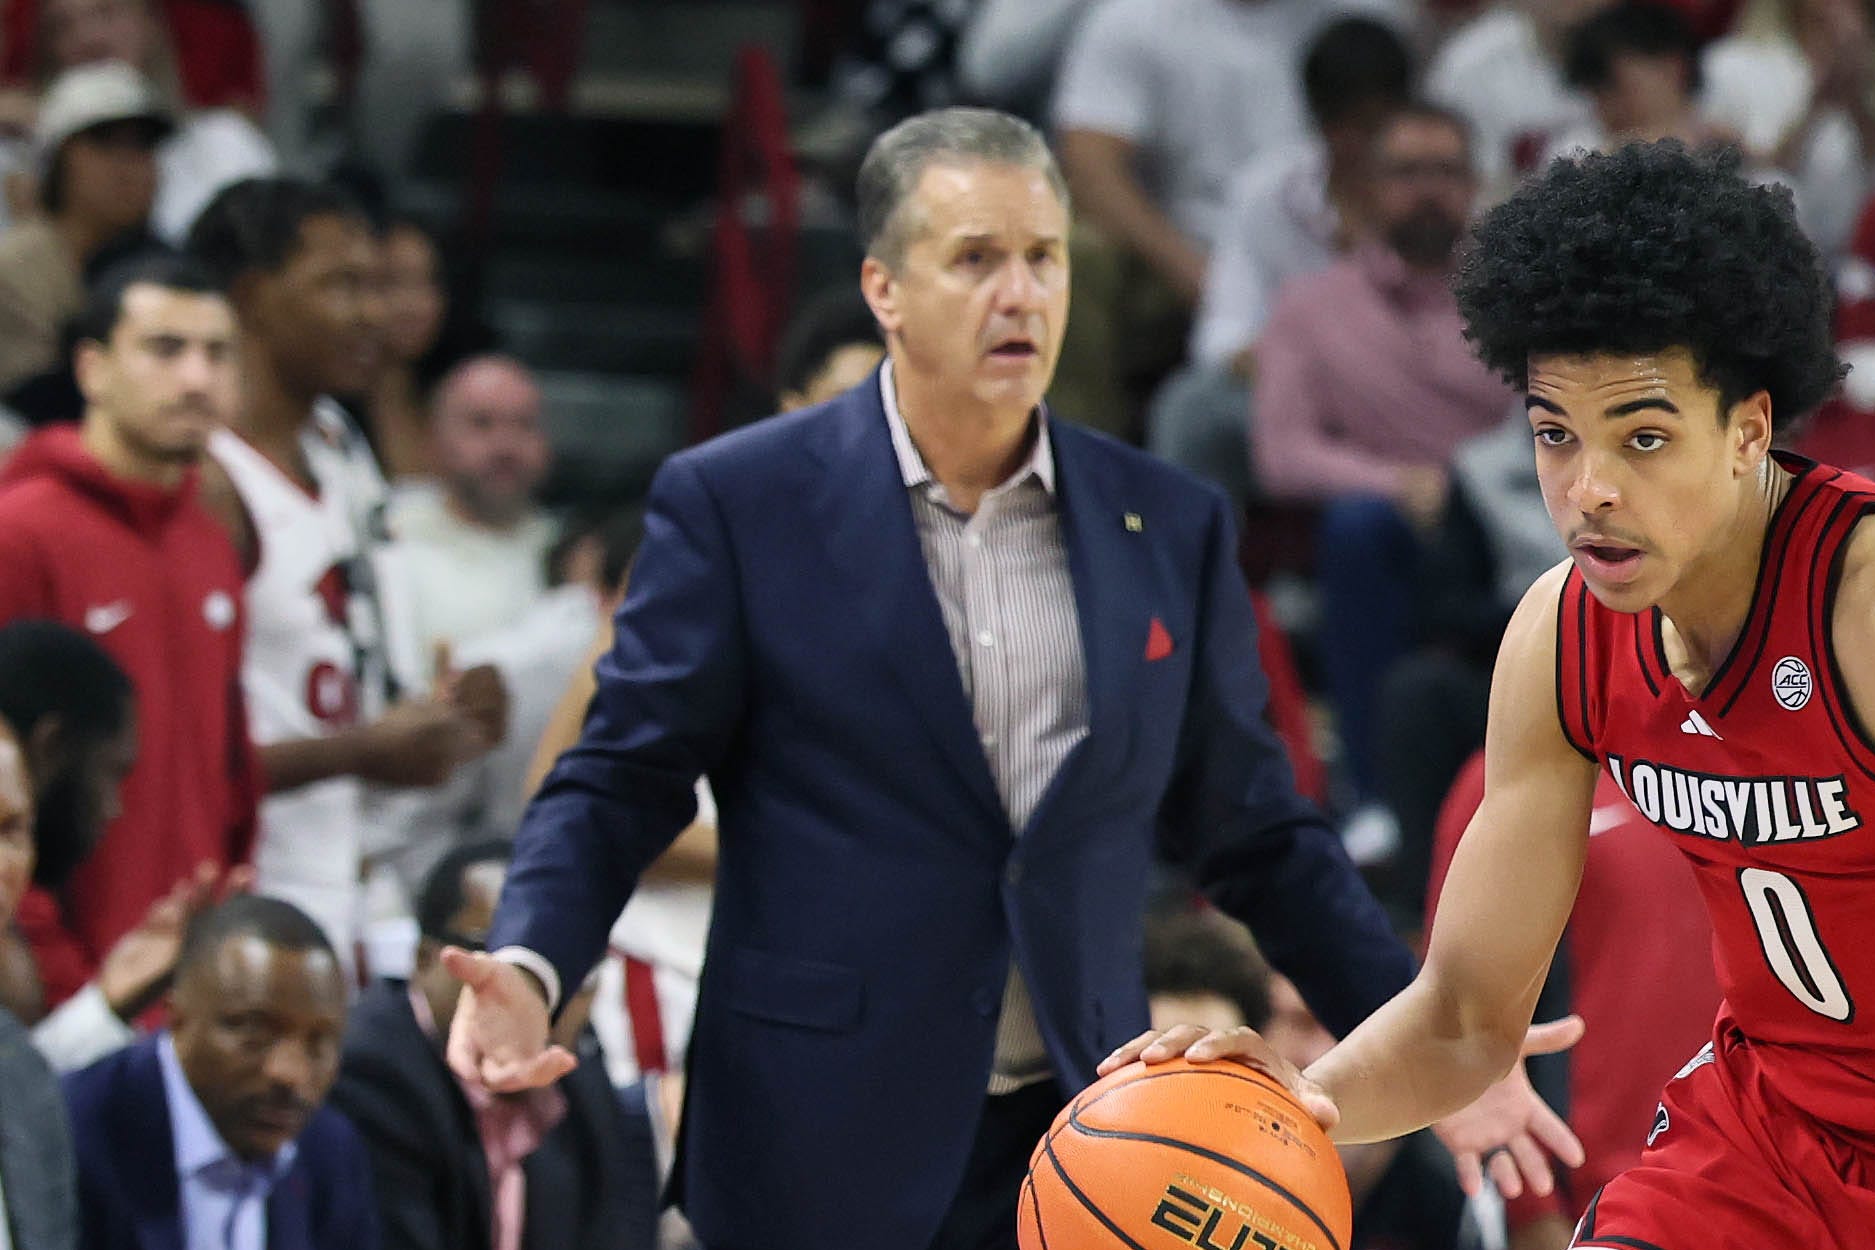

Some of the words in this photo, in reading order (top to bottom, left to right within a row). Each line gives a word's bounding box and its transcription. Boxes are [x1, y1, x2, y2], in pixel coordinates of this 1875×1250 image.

[1779, 674, 1809, 686] ACC
[1606, 753, 1862, 847] LOUISVILLE
[1737, 867, 1855, 1024] 0
